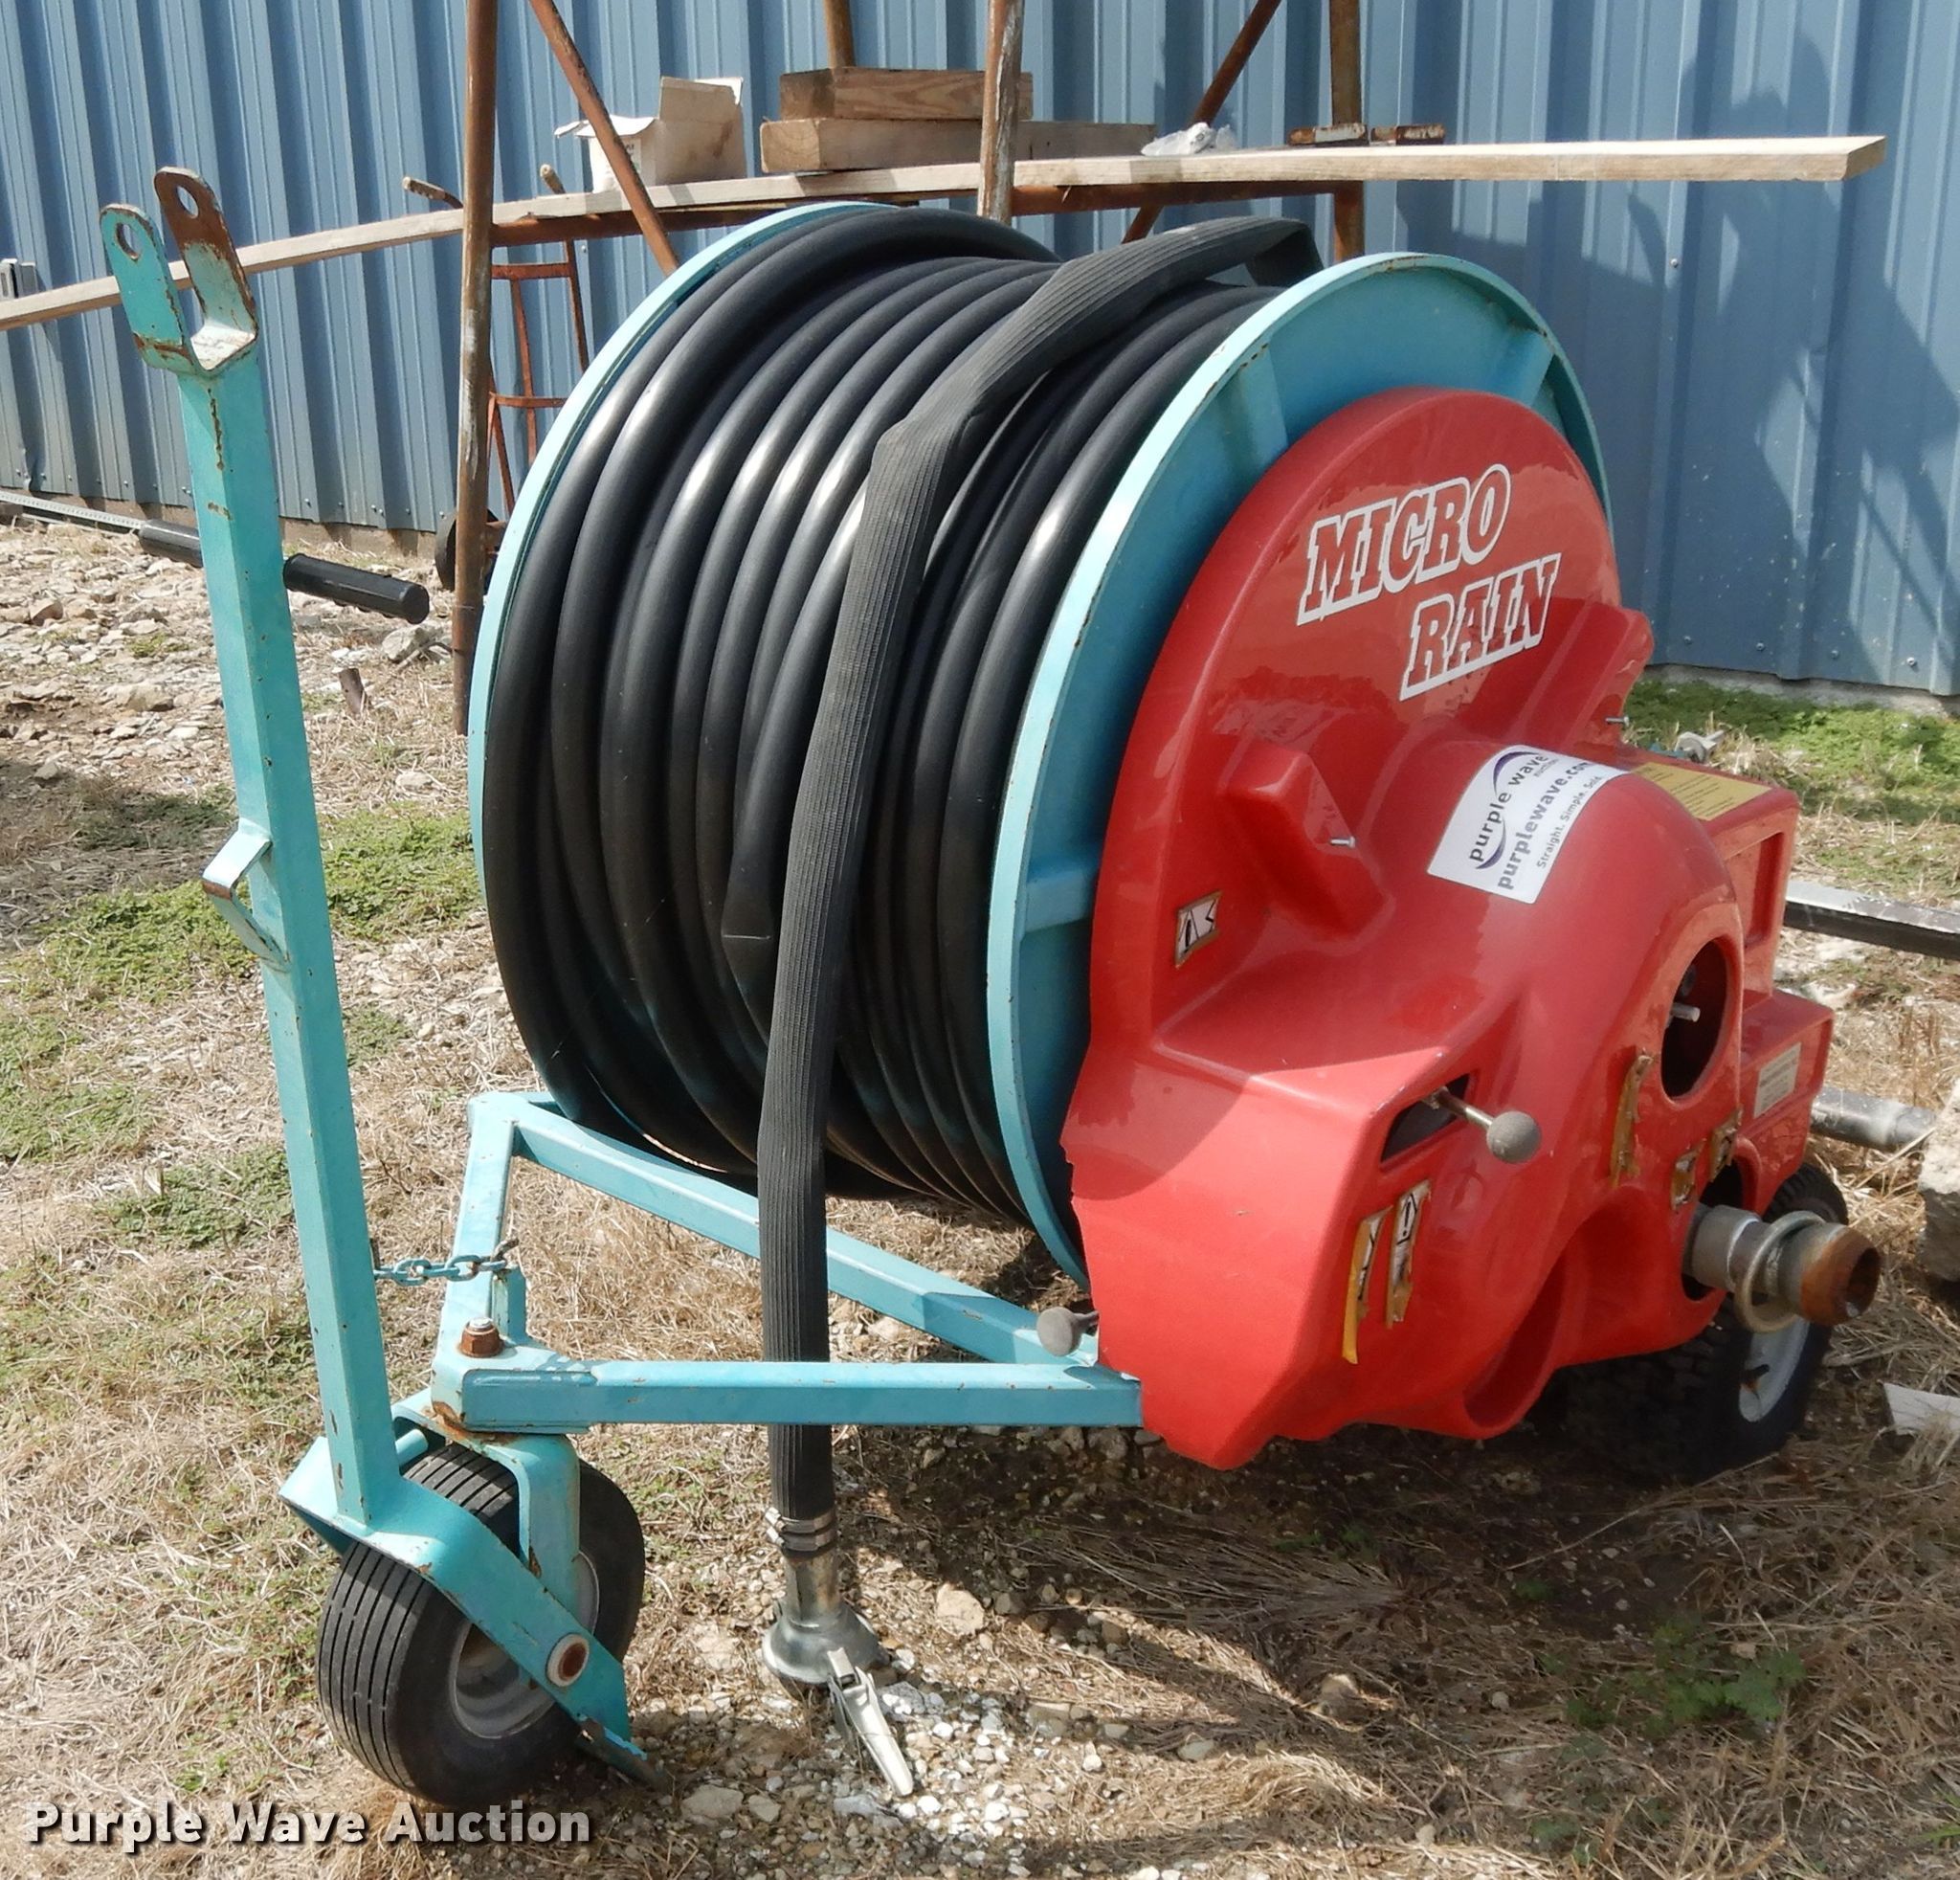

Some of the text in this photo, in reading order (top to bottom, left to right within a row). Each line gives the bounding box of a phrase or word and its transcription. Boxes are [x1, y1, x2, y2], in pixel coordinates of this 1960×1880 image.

[1297, 463, 1511, 626] MICRO
[1399, 552, 1562, 701] RAIN
[1469, 792, 1512, 862] purple
[1508, 754, 1548, 787] wave
